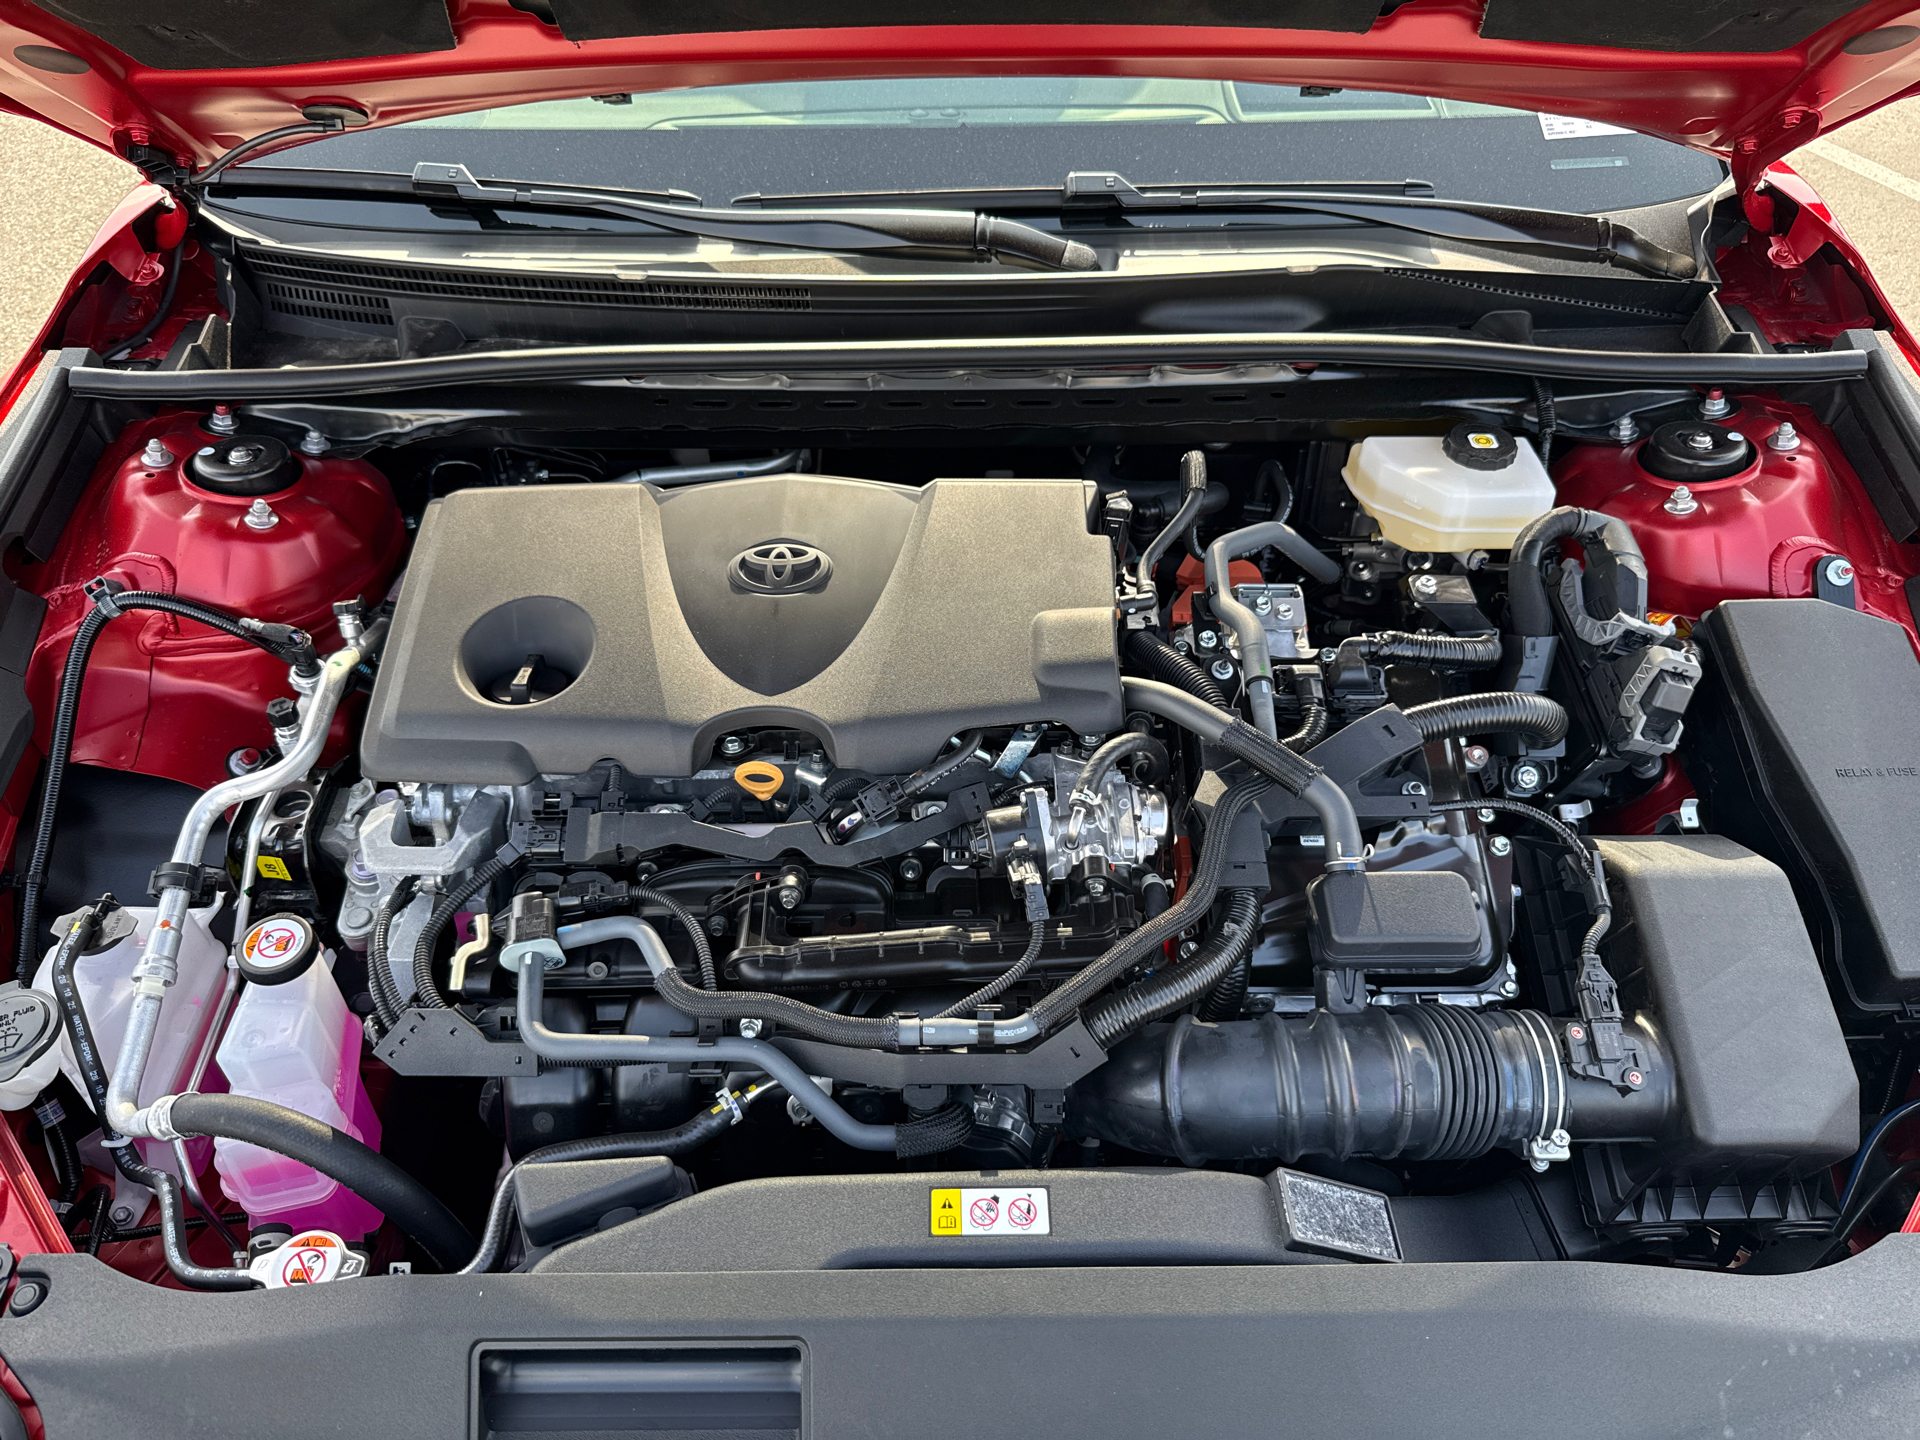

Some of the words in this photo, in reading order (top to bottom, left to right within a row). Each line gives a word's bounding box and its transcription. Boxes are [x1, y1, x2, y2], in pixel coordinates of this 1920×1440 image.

[1835, 767, 1873, 778] RELAY
[1876, 768, 1885, 777] &
[1886, 767, 1919, 777] FUSE
[13, 1005, 36, 1017] FLUID
[72, 1013, 86, 1038] WATER
